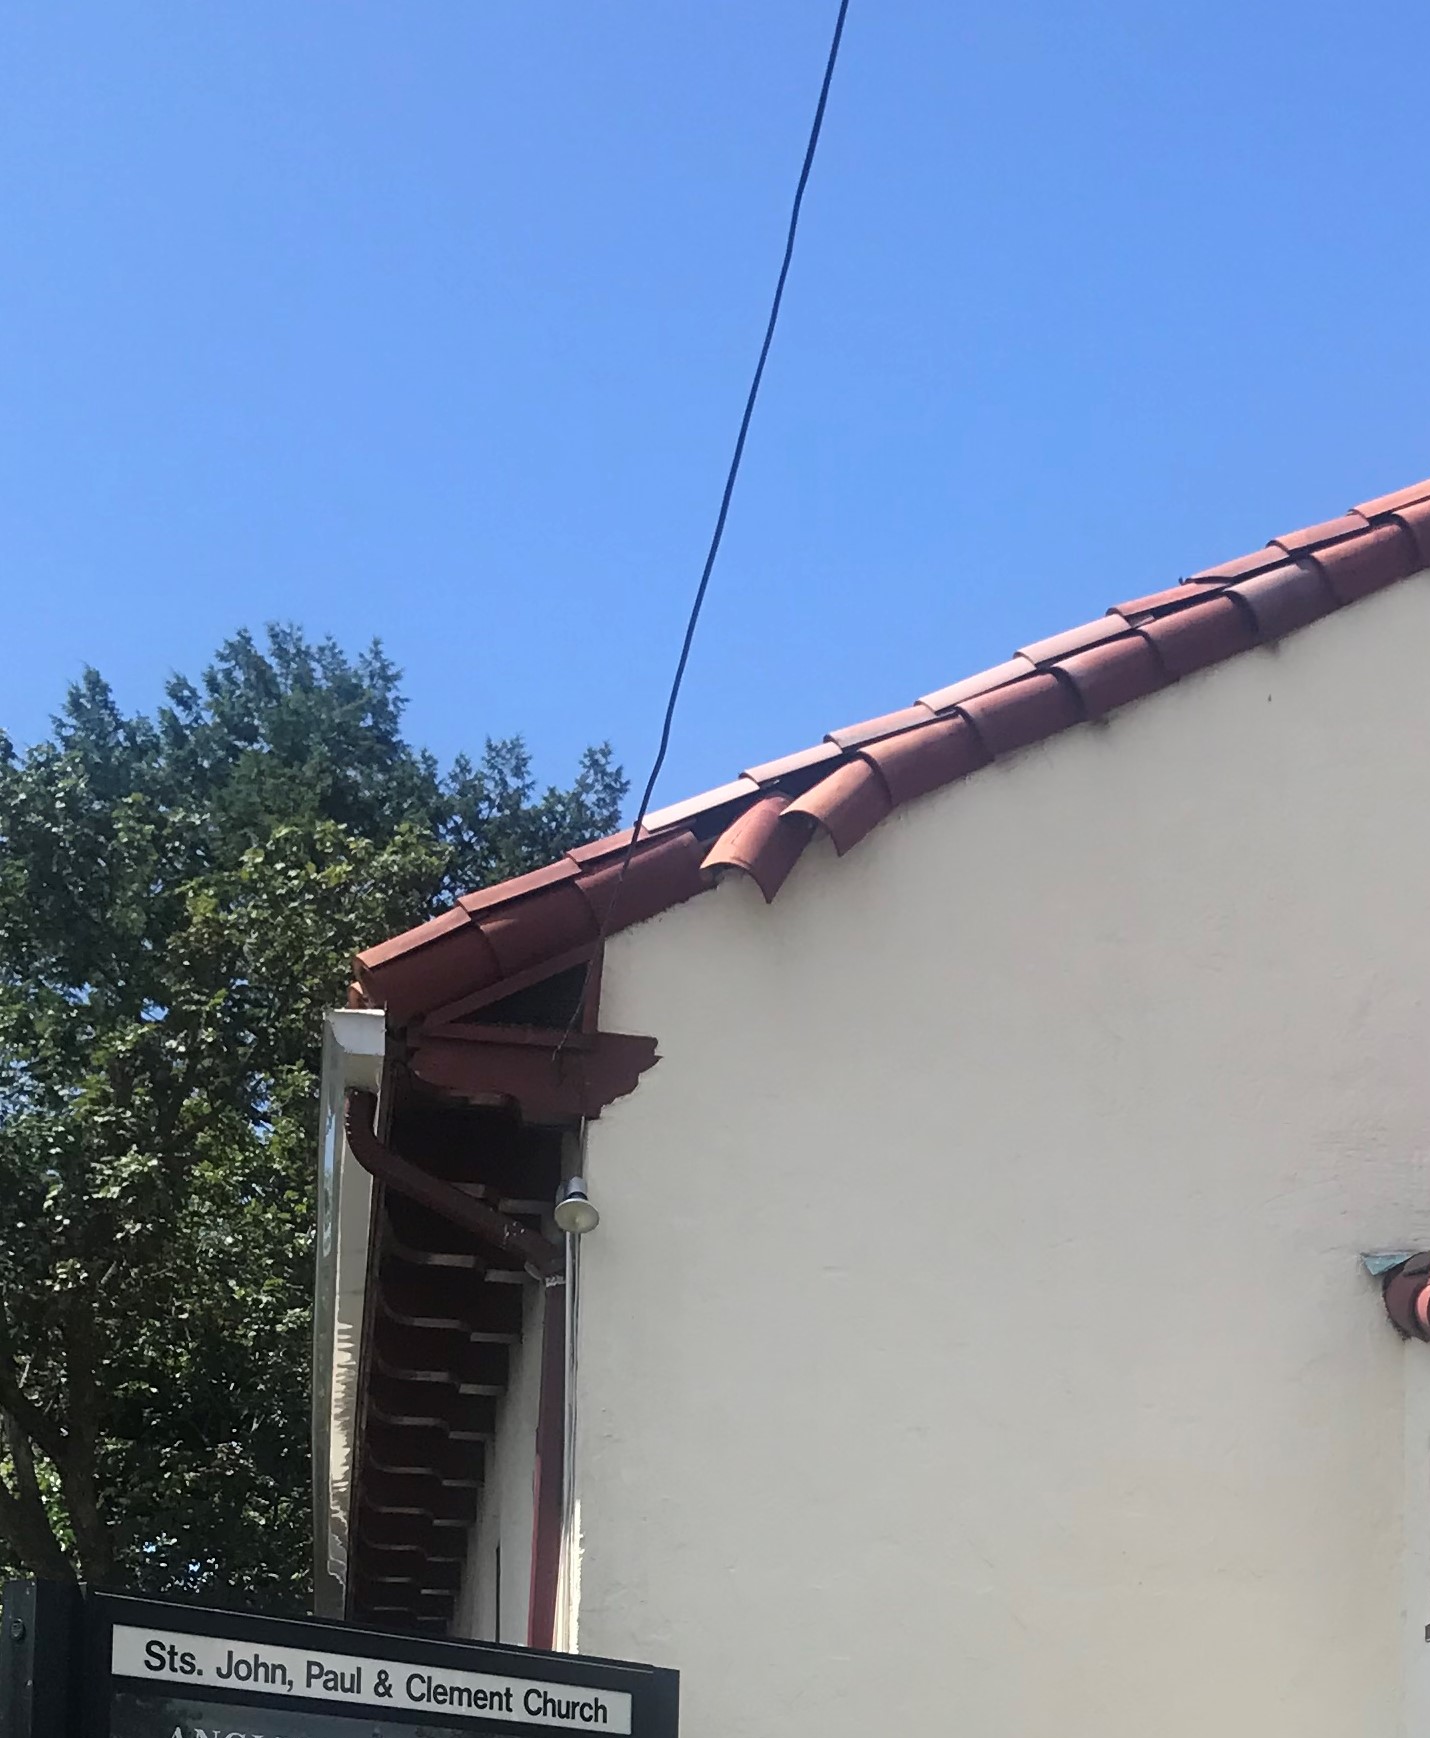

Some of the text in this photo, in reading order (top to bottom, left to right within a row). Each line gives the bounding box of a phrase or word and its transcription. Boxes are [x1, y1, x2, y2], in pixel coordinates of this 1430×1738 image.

[144, 1640, 608, 1725] Sts. John, Paul & Clement Church
